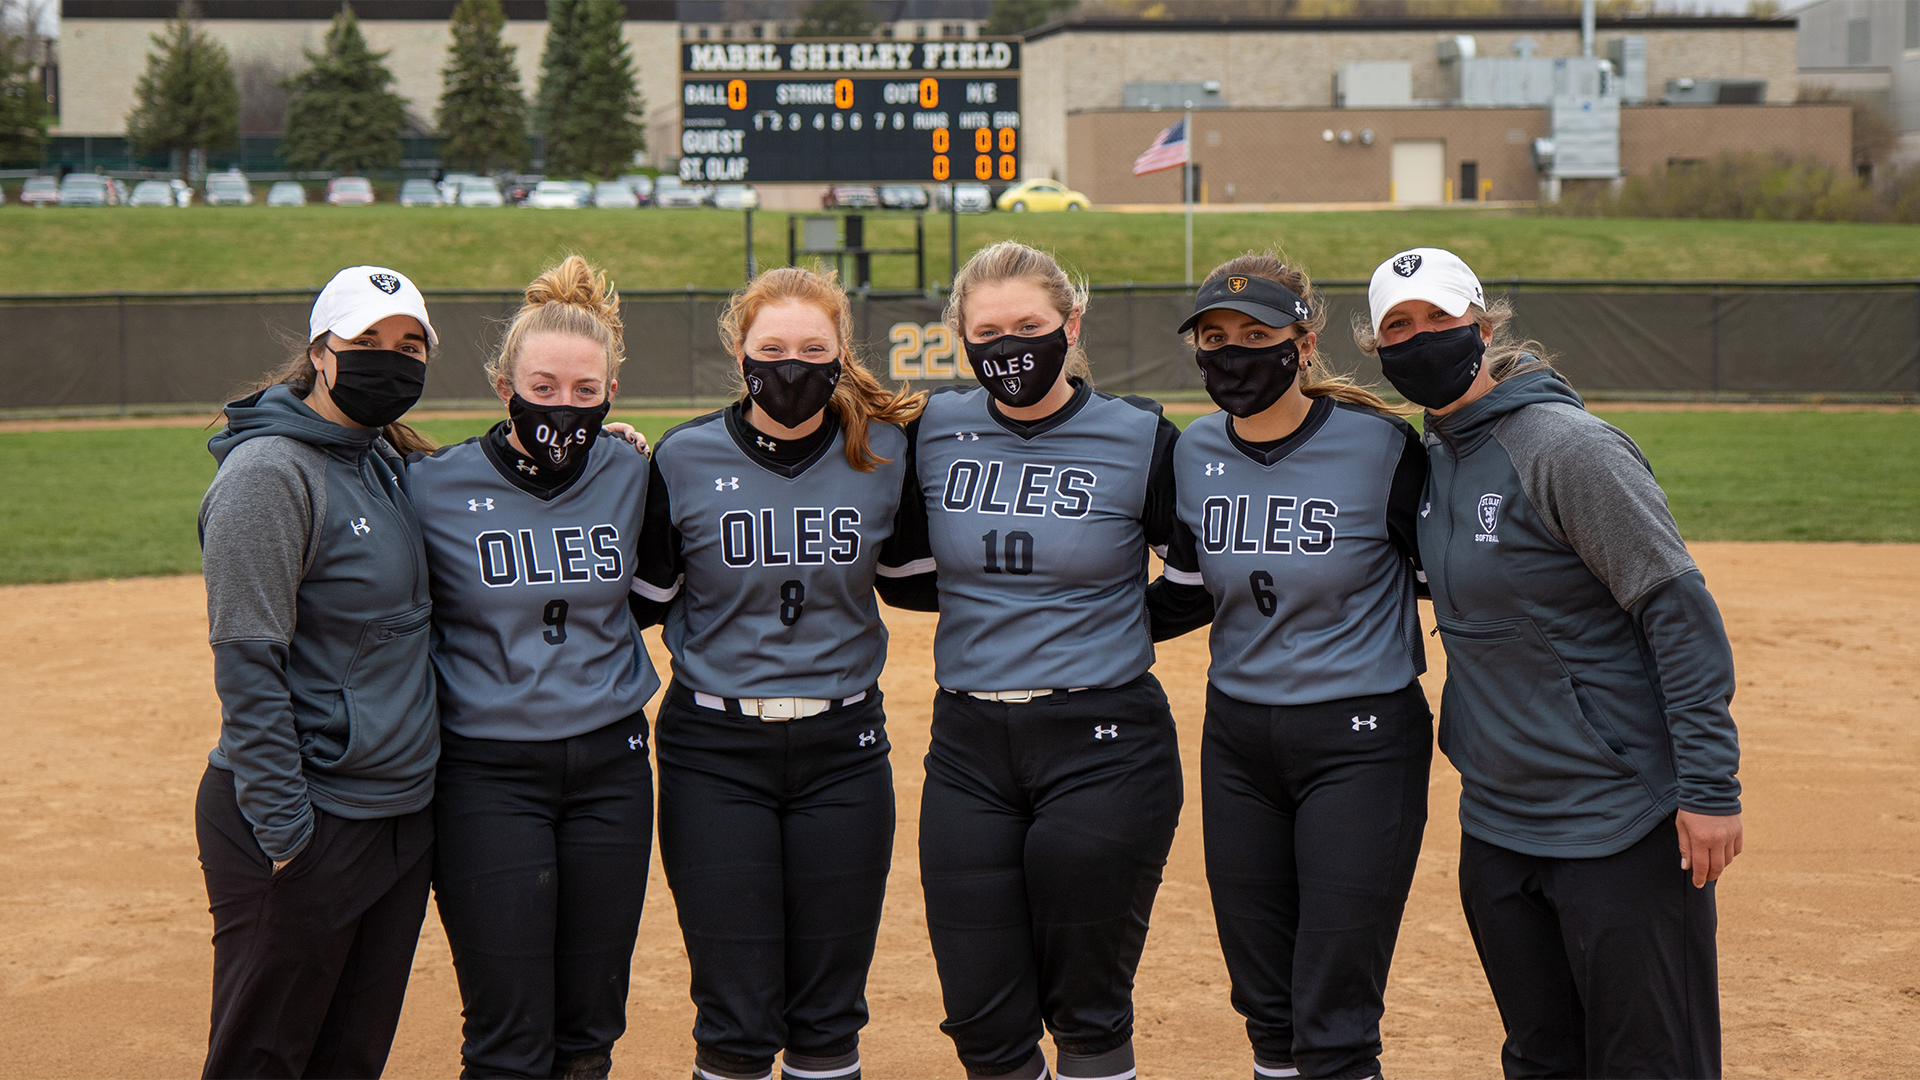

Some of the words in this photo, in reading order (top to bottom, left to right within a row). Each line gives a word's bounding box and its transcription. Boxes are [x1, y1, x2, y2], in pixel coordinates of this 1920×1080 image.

[690, 43, 782, 71] MABEL
[789, 43, 914, 71] SHIRLEY
[922, 42, 1012, 70] FIELD
[684, 84, 728, 105] BALL
[728, 79, 747, 110] 0
[776, 83, 835, 105] STRIKE
[835, 78, 854, 109] 0
[883, 83, 919, 105] OUT
[919, 77, 939, 109] 0
[753, 112, 764, 131] 1
[770, 112, 783, 131] 2
[789, 112, 802, 131] 3
[812, 112, 825, 131] 4
[831, 112, 844, 131] 5
[850, 111, 863, 131] 6
[873, 111, 886, 130] 7
[892, 111, 905, 130] 8
[912, 111, 949, 130] RUNS
[958, 111, 989, 130] HITS
[682, 129, 746, 154] GUEST
[932, 128, 950, 154] 0
[975, 127, 992, 153] 0
[998, 127, 1016, 153] 0
[679, 156, 705, 181] ST.
[705, 156, 749, 181] OLAF
[932, 154, 950, 181] 0
[975, 154, 993, 180] 0
[998, 154, 1016, 180] 0
[982, 353, 1035, 378] OLES
[535, 424, 587, 448] OLES
[942, 459, 1097, 519] OLES
[719, 507, 861, 567] OLES
[1202, 495, 1338, 555] OLES
[475, 524, 623, 588] OLES
[982, 530, 1033, 575] 10
[780, 580, 804, 626] 8
[1249, 570, 1277, 618] 6
[542, 599, 569, 645] 9
